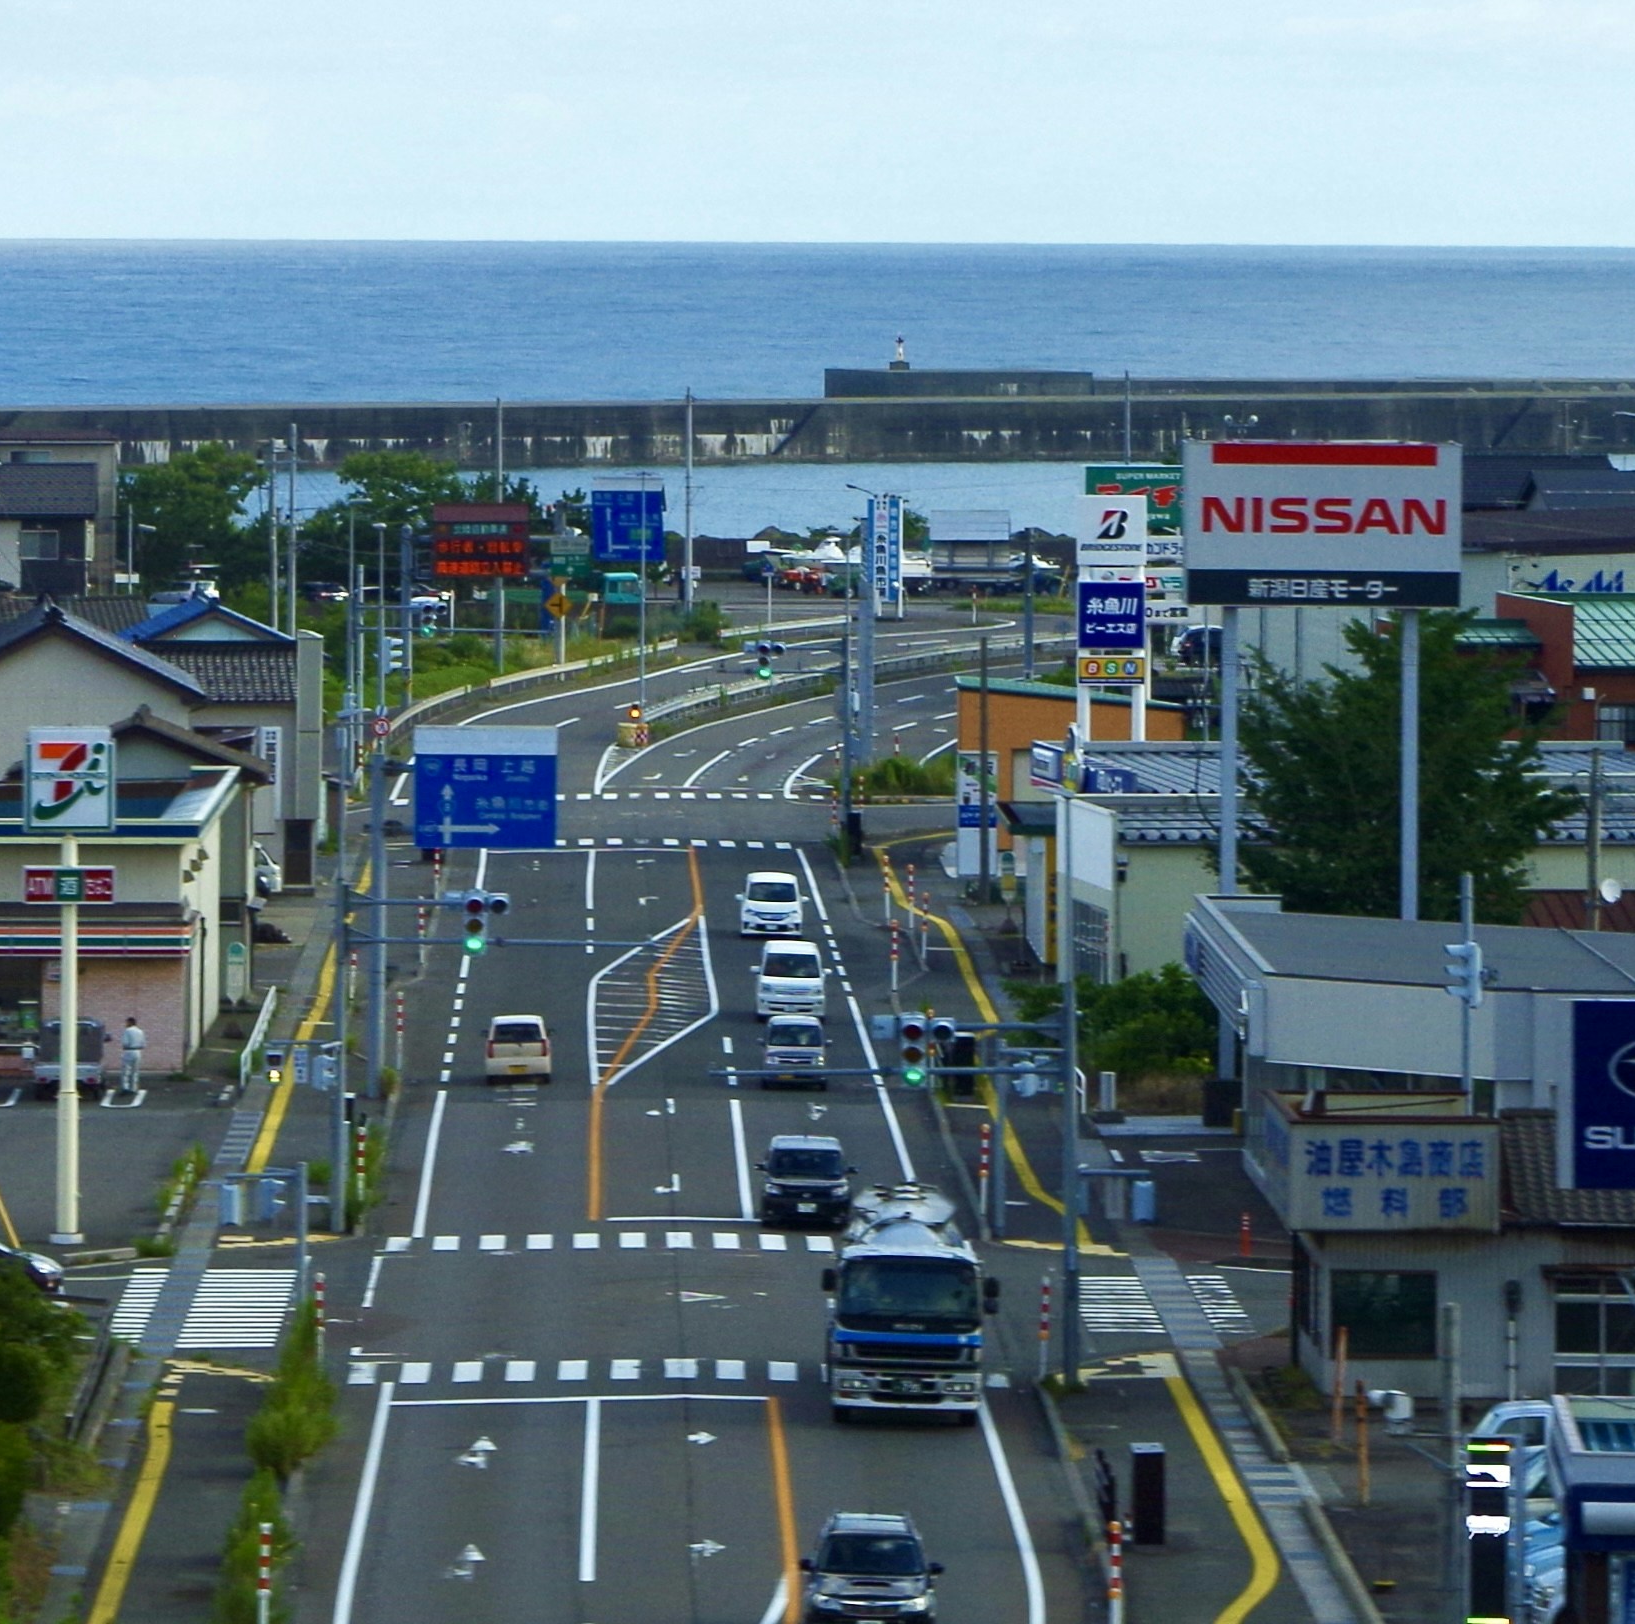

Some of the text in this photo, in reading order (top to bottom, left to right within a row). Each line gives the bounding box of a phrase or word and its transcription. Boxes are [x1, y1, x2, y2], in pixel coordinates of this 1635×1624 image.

[1201, 496, 1447, 535] NISSAN
[1080, 543, 1142, 552] BRIDGESTONE
[1246, 578, 1399, 600] 新潟日産モーター
[1085, 597, 1138, 617] 糸魚川
[28, 877, 54, 895] ATM
